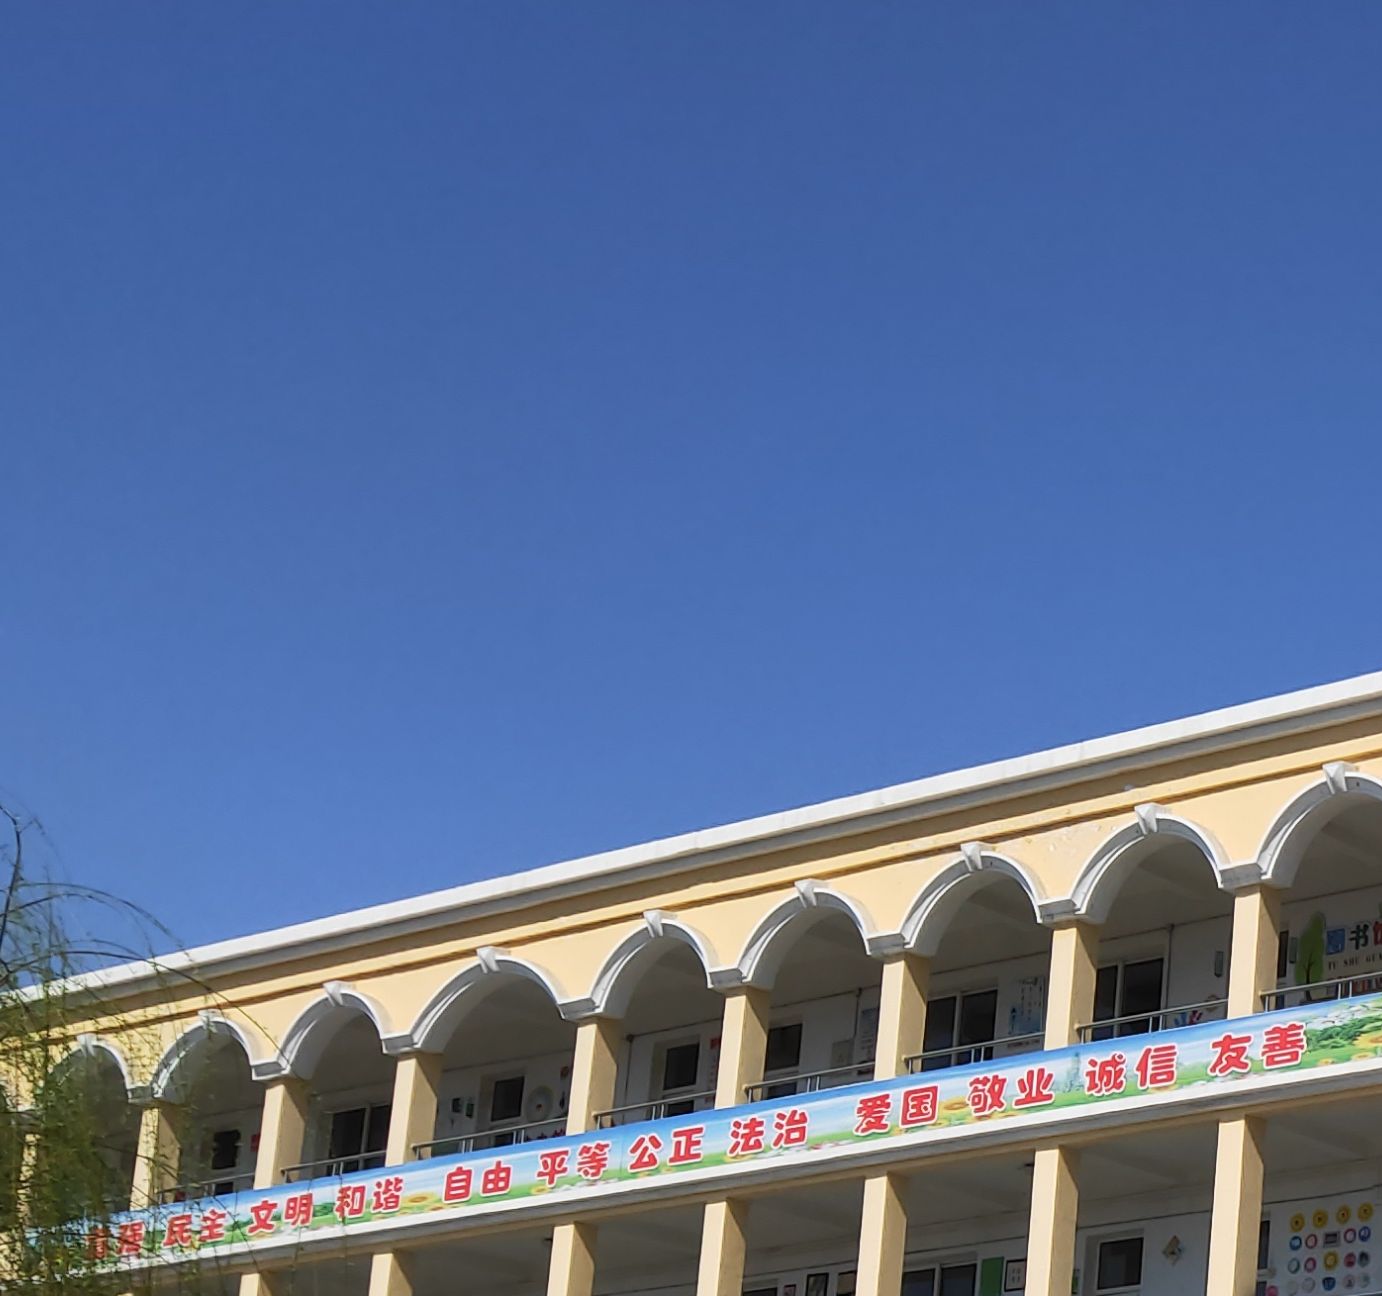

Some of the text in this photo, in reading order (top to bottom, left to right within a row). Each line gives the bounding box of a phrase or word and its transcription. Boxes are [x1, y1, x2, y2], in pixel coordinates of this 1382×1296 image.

[162, 1208, 226, 1248] 民主
[248, 1193, 313, 1233] 文明
[334, 1176, 403, 1220] 和谐
[444, 1161, 513, 1204] 自由
[537, 1142, 611, 1187] 平等
[629, 1126, 706, 1172] 公正
[728, 1108, 809, 1157] 法治
[855, 1085, 939, 1136] 爱国
[967, 1066, 1054, 1118] 敬业
[1084, 1045, 1178, 1097] 诚信
[1208, 1023, 1308, 1077] 友善
